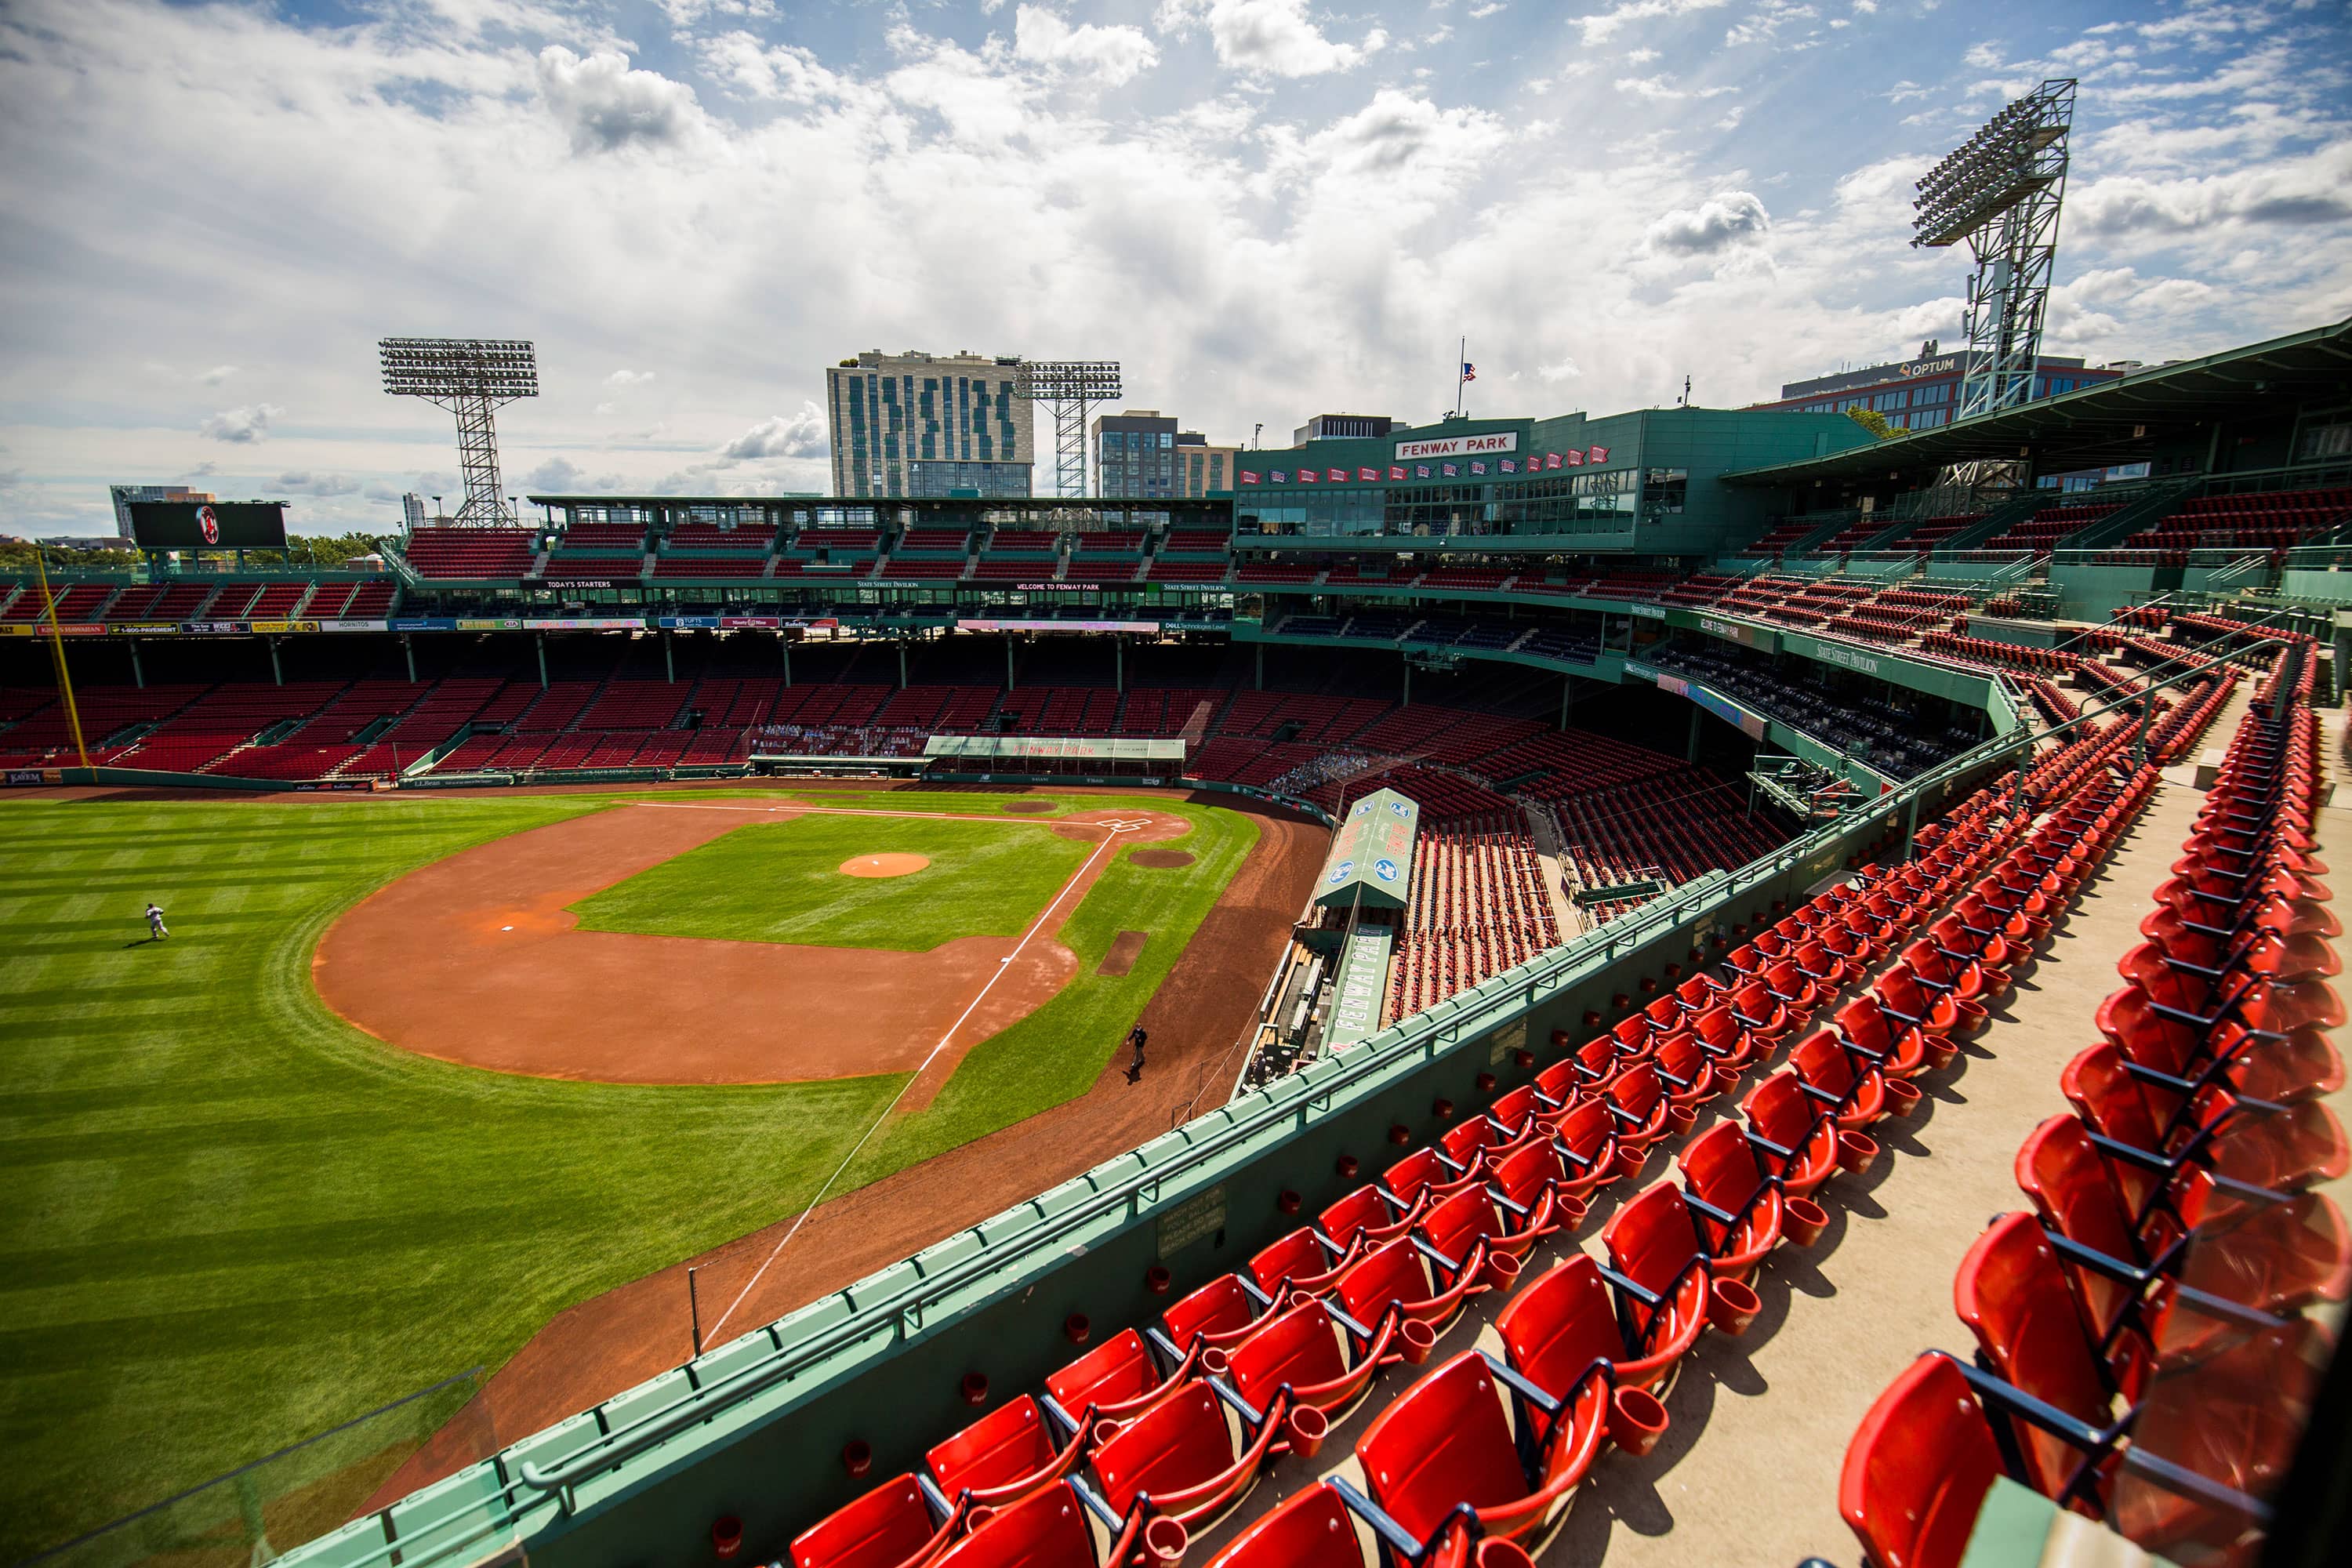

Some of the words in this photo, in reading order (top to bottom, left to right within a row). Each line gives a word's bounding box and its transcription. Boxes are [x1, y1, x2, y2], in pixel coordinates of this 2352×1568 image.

[1912, 358, 1955, 376] OPTUM
[1402, 441, 1459, 457] FENWAY
[1466, 436, 1508, 452] PARK
[1817, 644, 1831, 659] STATE
[1831, 647, 1850, 665] STREET
[1850, 652, 1878, 673] PAVILION
[1013, 746, 1060, 755] FENWAY
[1063, 746, 1094, 755] PARK
[10, 772, 41, 783] KAYEM
[1352, 927, 1382, 963] PARK
[1335, 964, 1375, 1033] FENWAY
